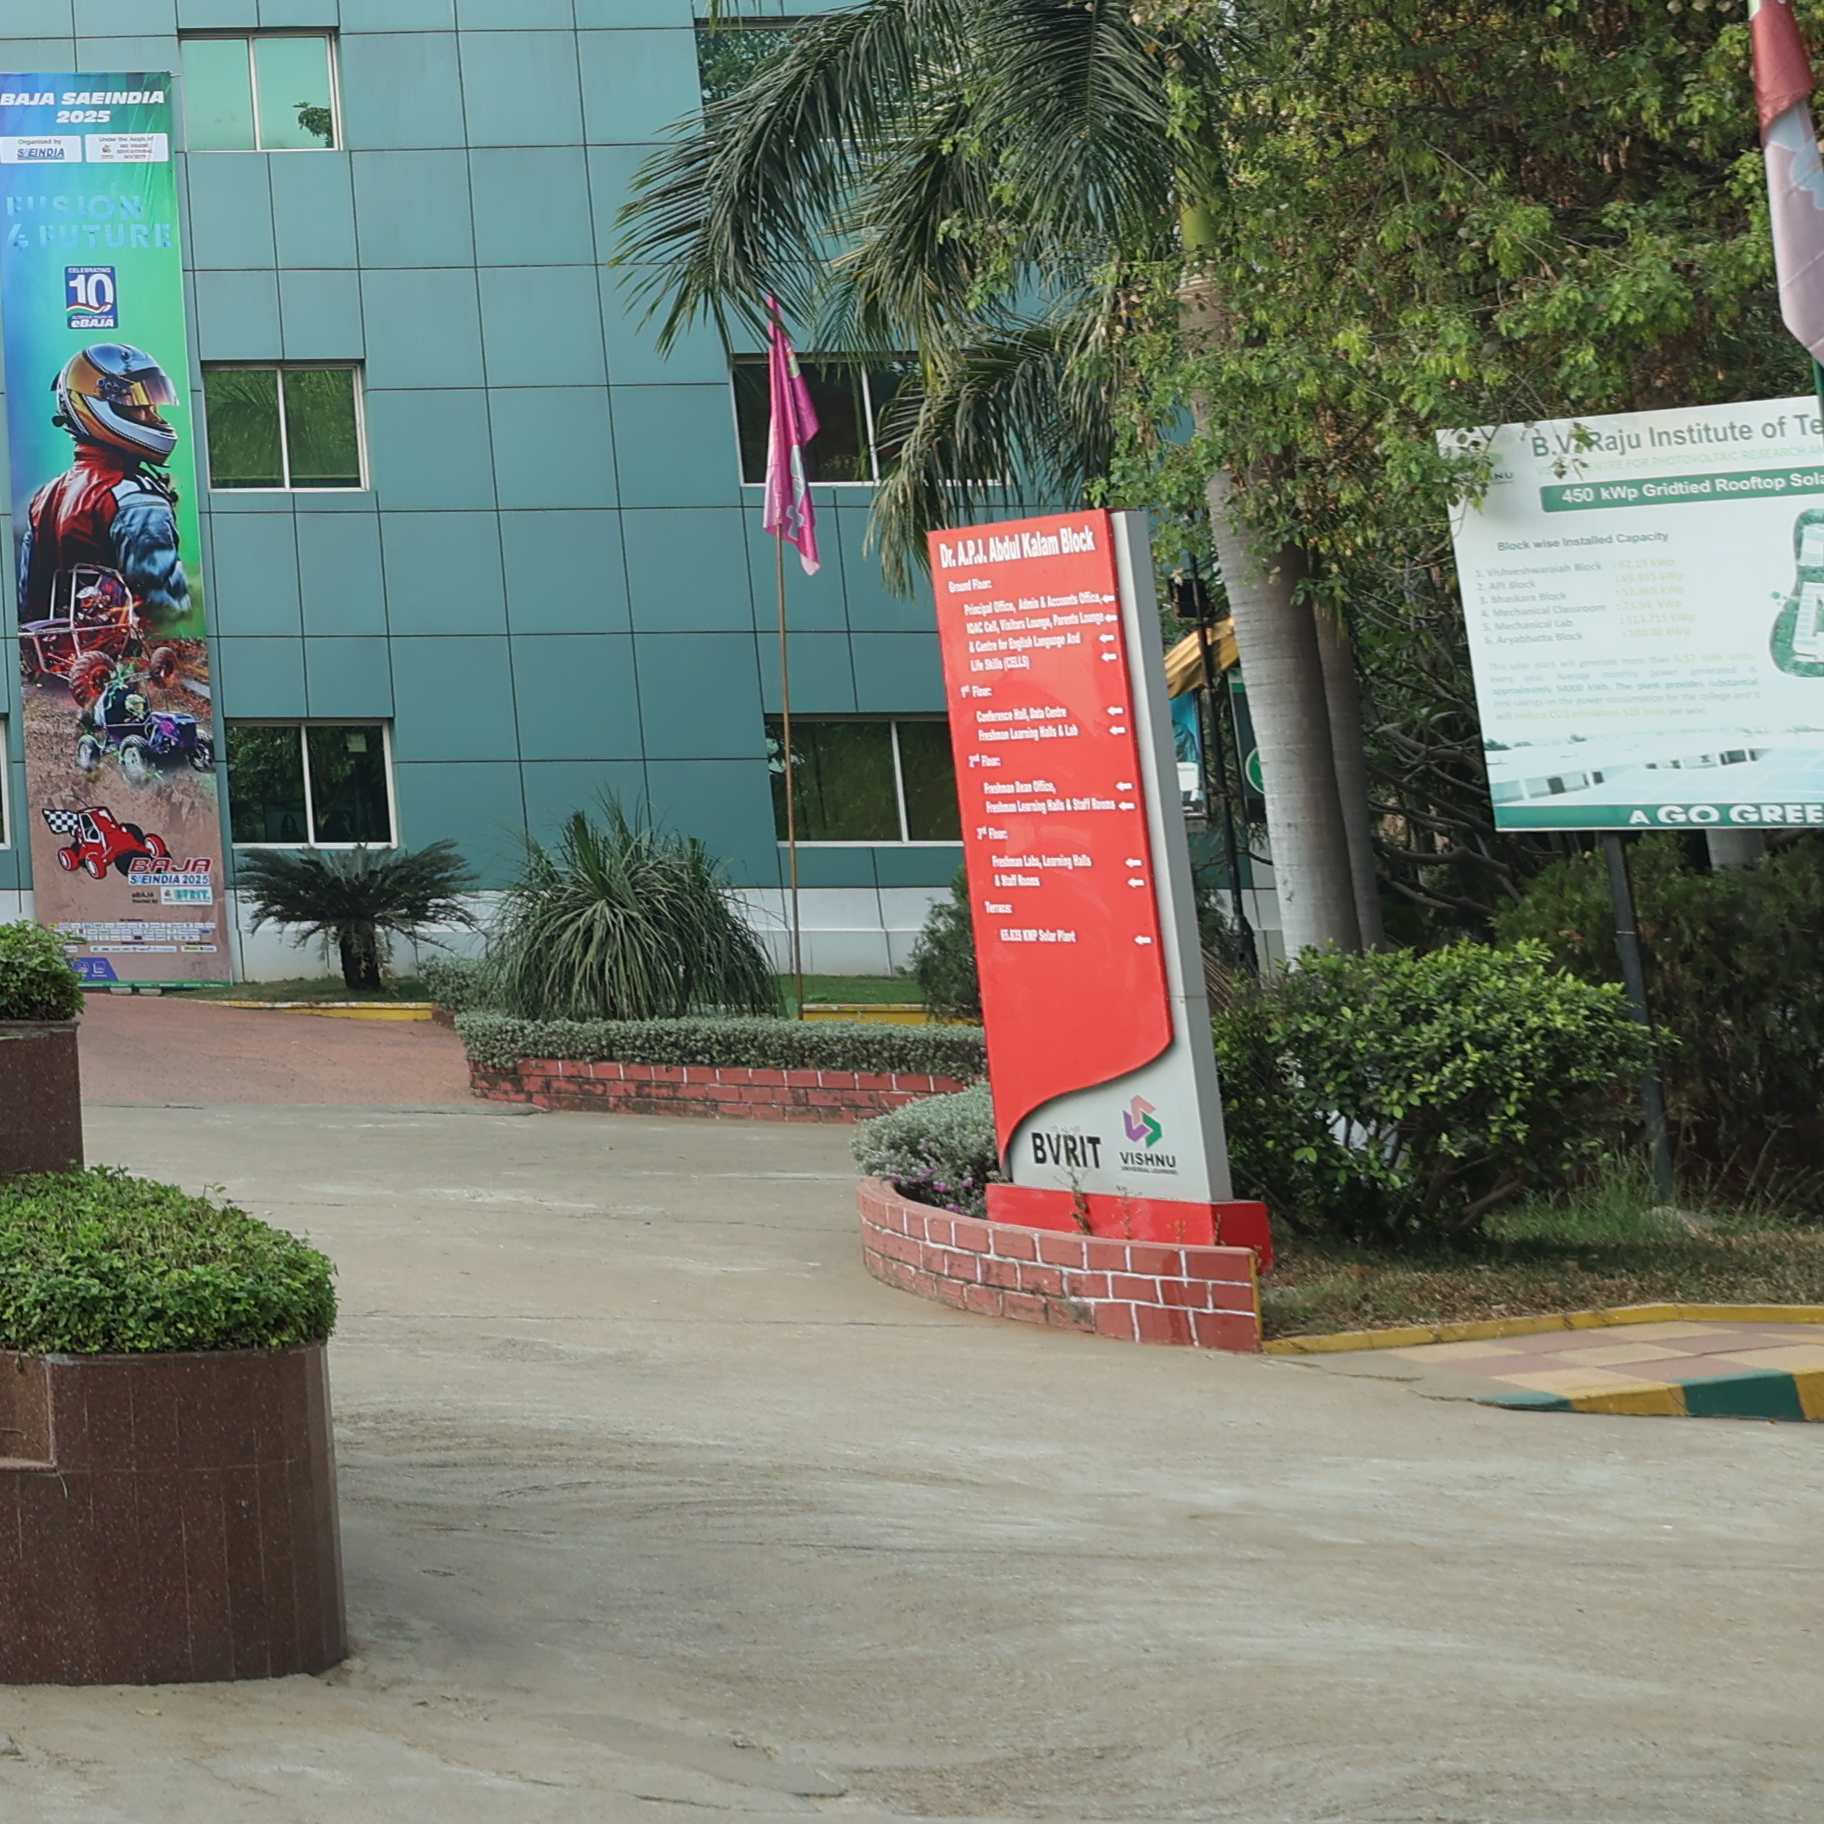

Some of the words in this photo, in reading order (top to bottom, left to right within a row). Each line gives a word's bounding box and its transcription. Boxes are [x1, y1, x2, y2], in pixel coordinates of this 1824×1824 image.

[0, 92, 55, 106] BAJA
[61, 91, 164, 105] SAEINDIA
[56, 110, 111, 124] 2025
[69, 273, 114, 307] 10
[71, 318, 114, 328] eBAJA
[1587, 428, 1641, 456] Raju
[1648, 421, 1753, 447] Institute
[1761, 416, 1786, 438] of
[1562, 487, 1593, 503] 450
[1601, 485, 1638, 501] kWp
[1642, 480, 1711, 497] Gridtied
[1715, 476, 1786, 491] Rooftop
[939, 543, 956, 568] Dr.
[958, 539, 987, 566] A.P.J.
[989, 534, 1021, 562] Abdul
[1022, 531, 1060, 559] Kalam
[1059, 525, 1096, 553] Block
[1497, 541, 1530, 551] Block
[1532, 540, 1560, 549] wise
[1563, 535, 1613, 547] Installed
[1616, 533, 1669, 544] Capacity
[948, 580, 972, 593] Ground
[964, 602, 992, 616] Principal
[1629, 810, 1650, 825] A
[1657, 805, 1720, 823] GO
[129, 857, 212, 873] BAJA
[183, 875, 209, 884] 2025
[1031, 1132, 1101, 1169] BVRIT
[1119, 1151, 1176, 1168] VISHNU
